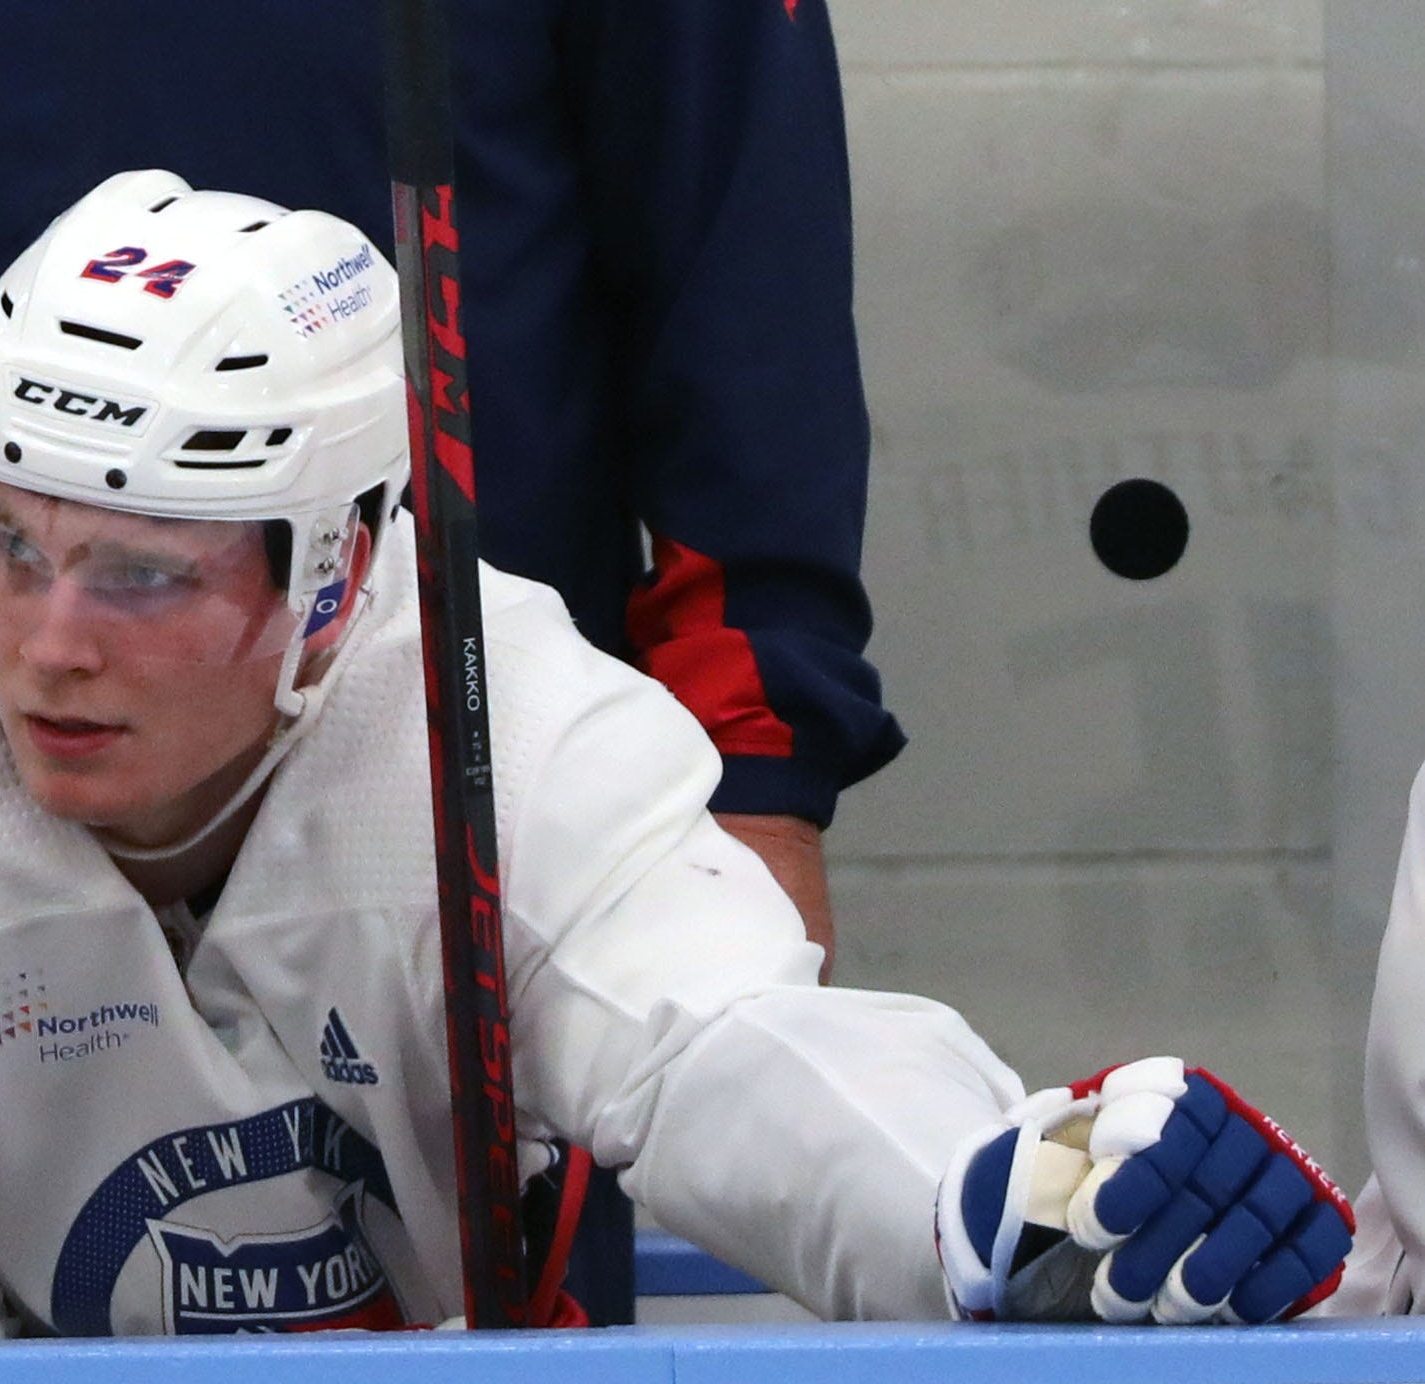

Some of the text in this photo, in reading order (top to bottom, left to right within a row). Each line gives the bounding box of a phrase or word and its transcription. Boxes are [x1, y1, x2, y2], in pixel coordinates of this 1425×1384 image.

[79, 245, 197, 300] 24
[311, 242, 375, 295] Northwell
[326, 283, 373, 323] Health
[14, 376, 148, 427] CCM
[462, 636, 481, 713] KAKKO
[37, 1003, 159, 1037] Northwell
[39, 1029, 122, 1063] Health
[136, 1104, 348, 1206] NEW YK
[179, 1262, 279, 1309] NEW
